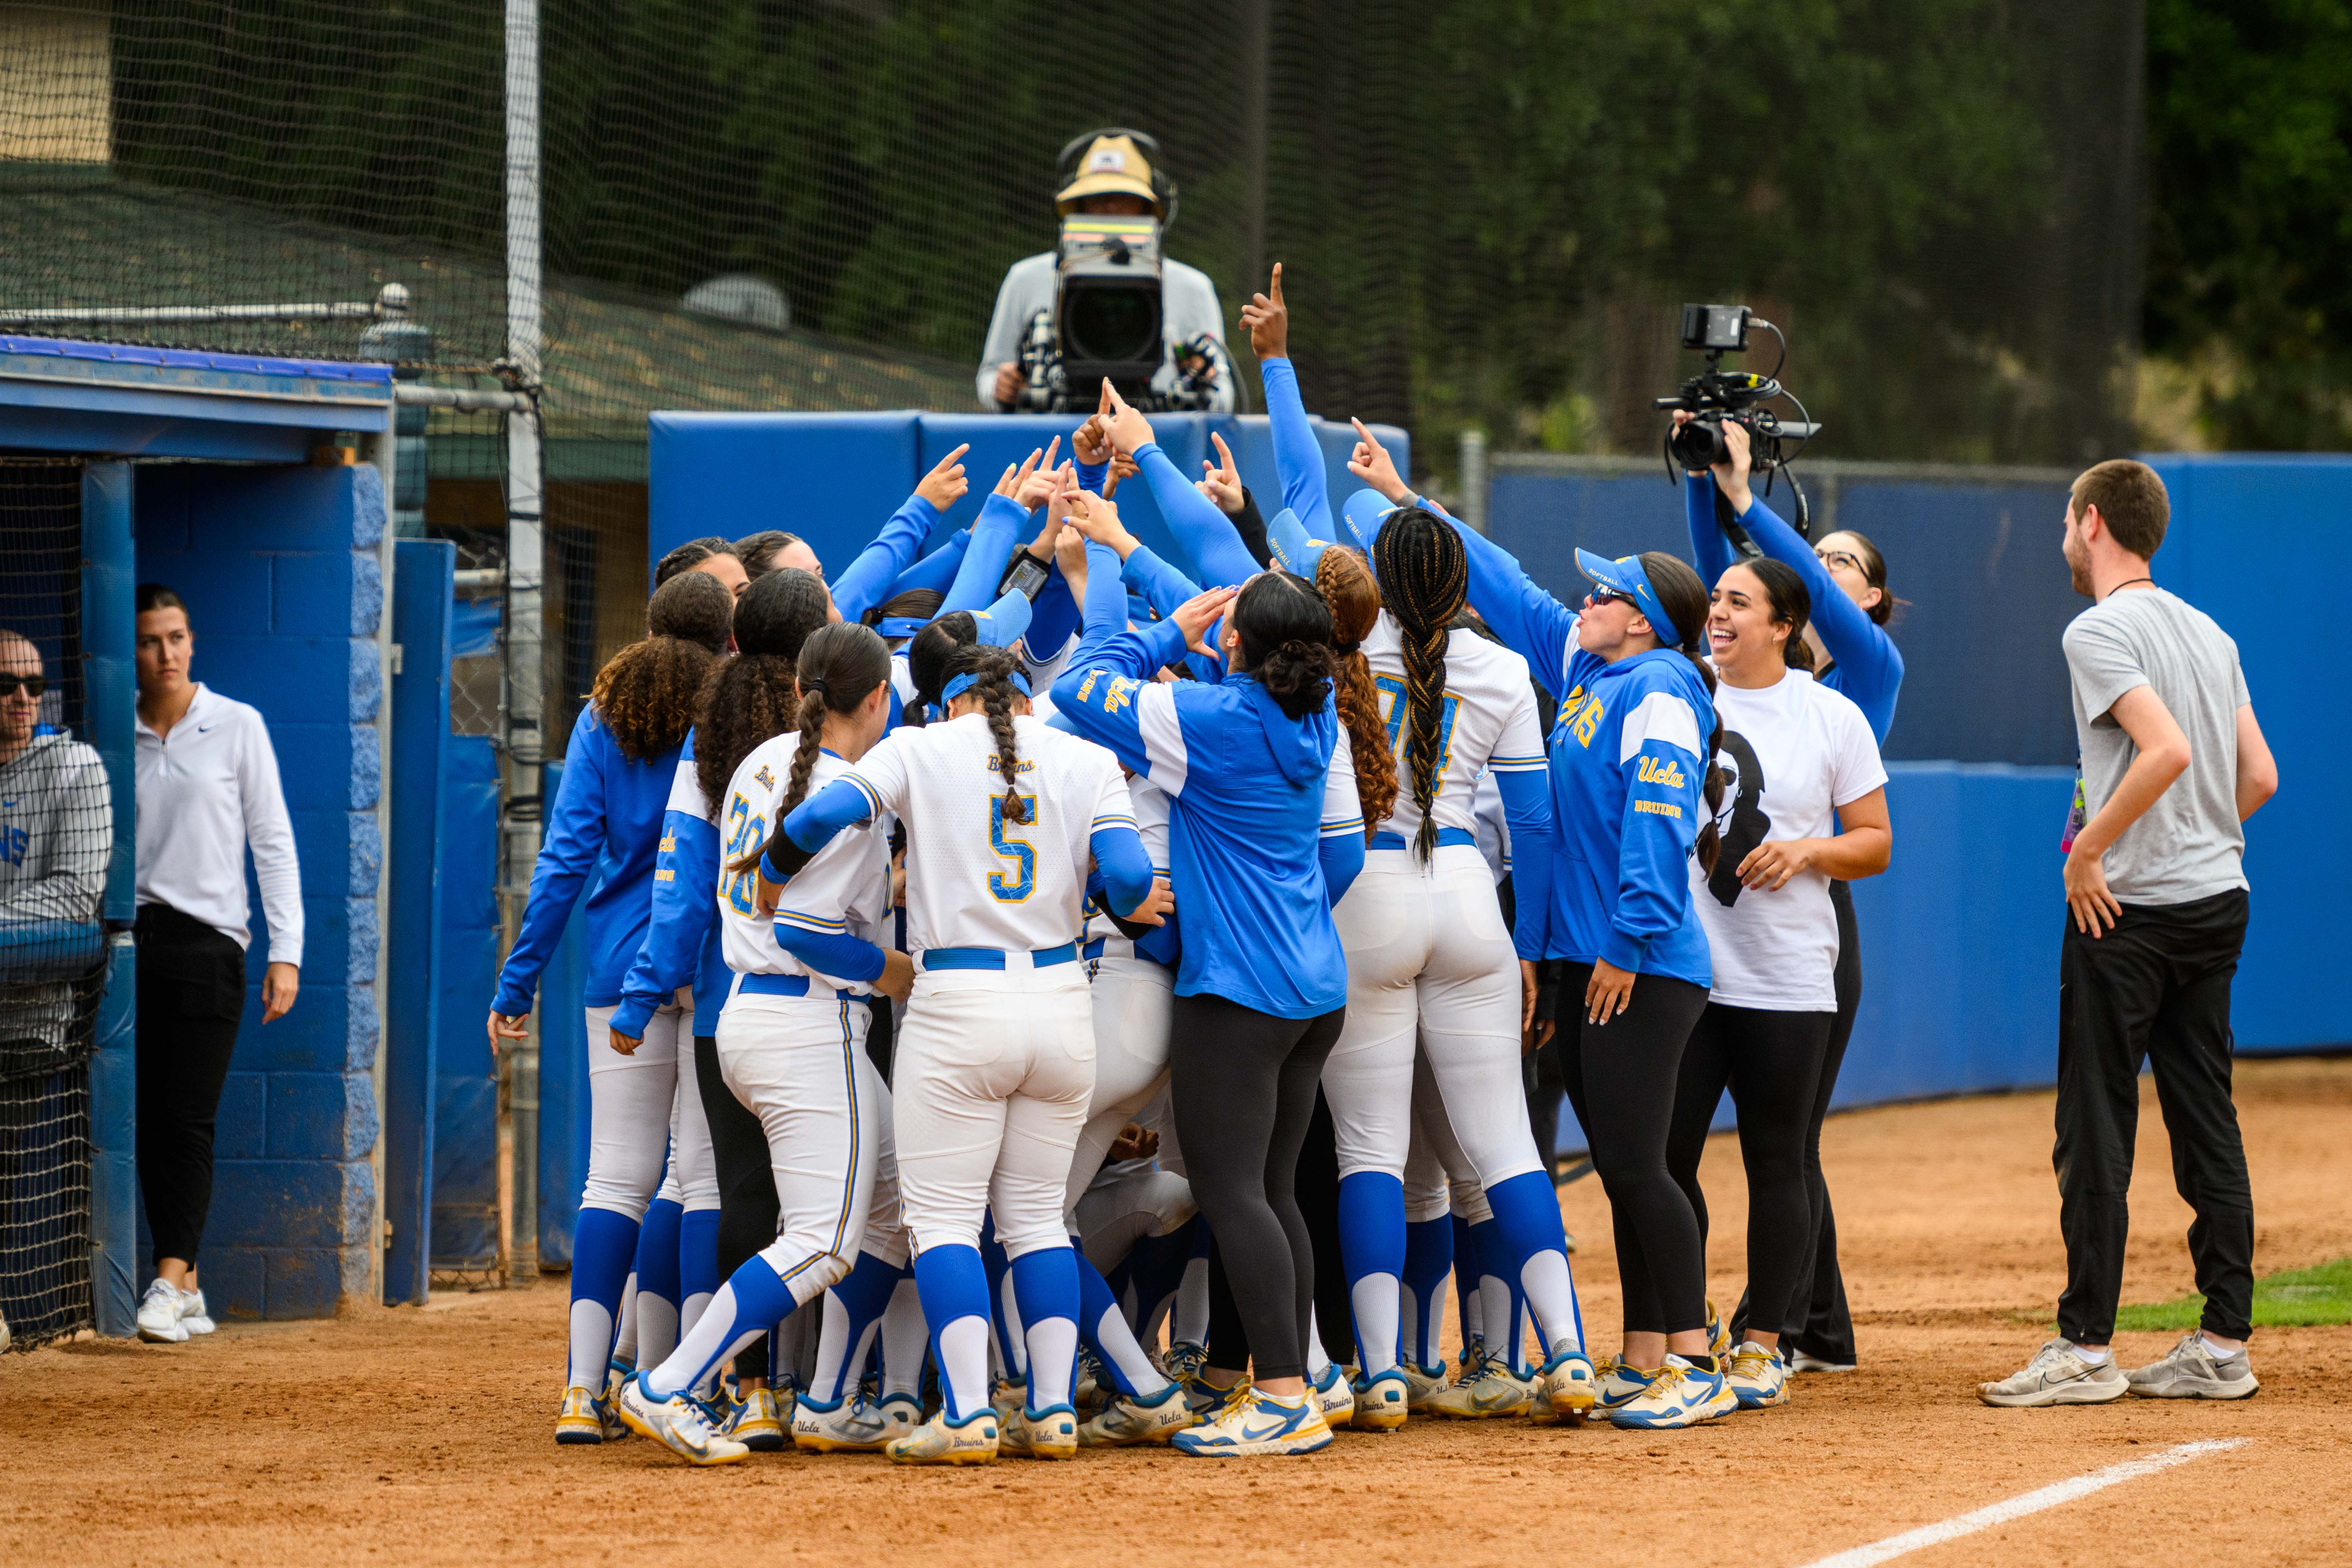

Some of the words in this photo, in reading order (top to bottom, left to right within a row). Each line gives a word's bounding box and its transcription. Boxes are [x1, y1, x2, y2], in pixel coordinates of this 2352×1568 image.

[1345, 514, 1363, 539] SOFTBALL
[1270, 538, 1290, 566] SOFTBALL
[1588, 568, 1618, 586] SOFTBALL
[754, 764, 775, 793] Bruin
[1638, 756, 1684, 789] Ucla
[1634, 800, 1681, 819] BRUINS
[659, 826, 676, 852] cla
[987, 794, 1038, 903] 5
[1526, 1389, 1537, 1399] Brui
[1552, 1379, 1566, 1394] Ucla
[622, 1394, 644, 1418] Bruins
[1322, 1397, 1352, 1412] Bruins
[1361, 1401, 1385, 1412] Bruins
[798, 1420, 820, 1433] Ucla
[1159, 1410, 1182, 1426] Ucla
[953, 1437, 984, 1447] Bruins
[1036, 1430, 1053, 1442] Ucla
